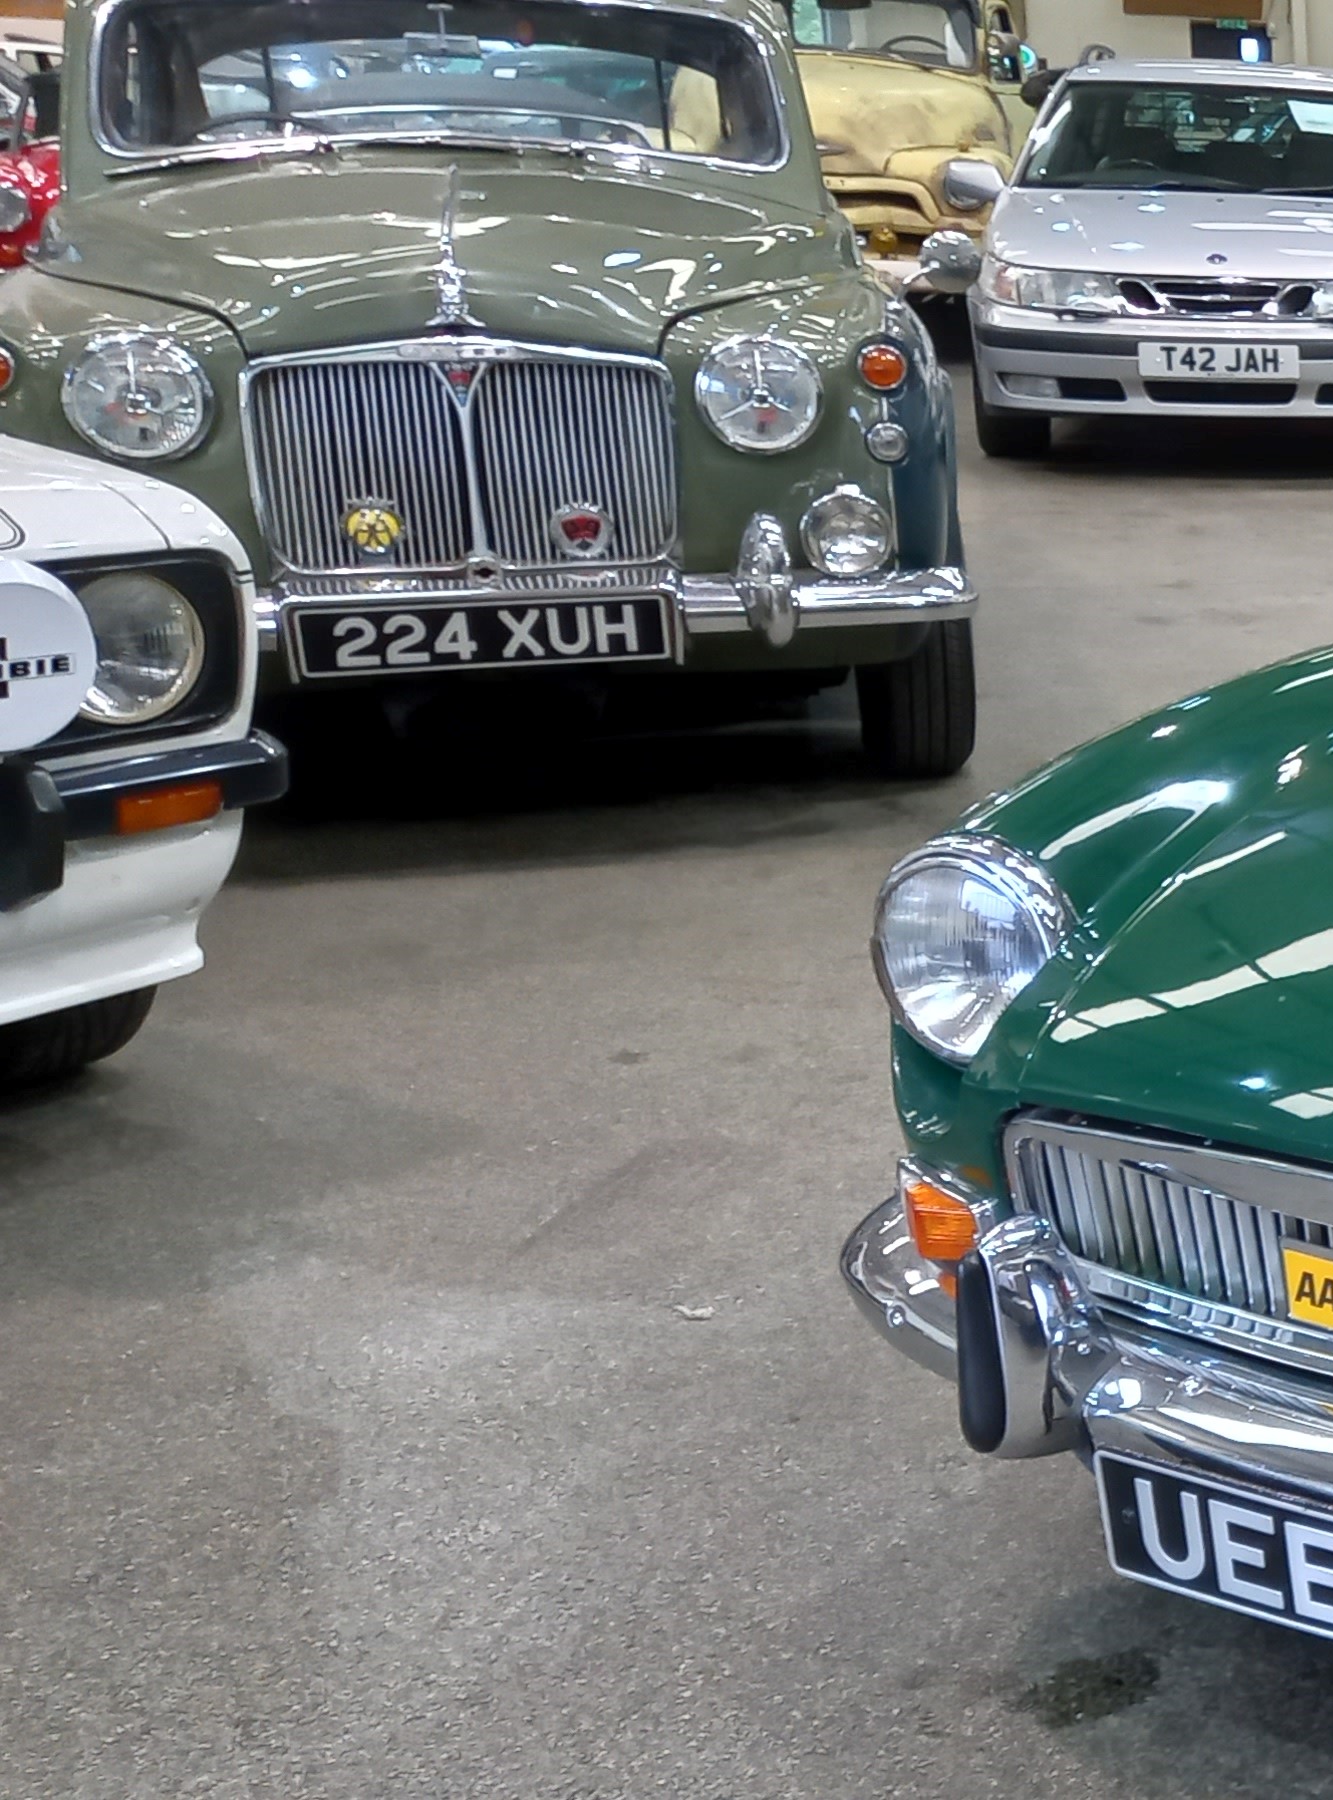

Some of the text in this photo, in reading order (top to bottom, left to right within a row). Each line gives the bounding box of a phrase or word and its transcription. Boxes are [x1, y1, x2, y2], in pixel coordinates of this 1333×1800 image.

[1160, 346, 1279, 373] T42 JAH
[332, 603, 639, 668] 224 XUH
